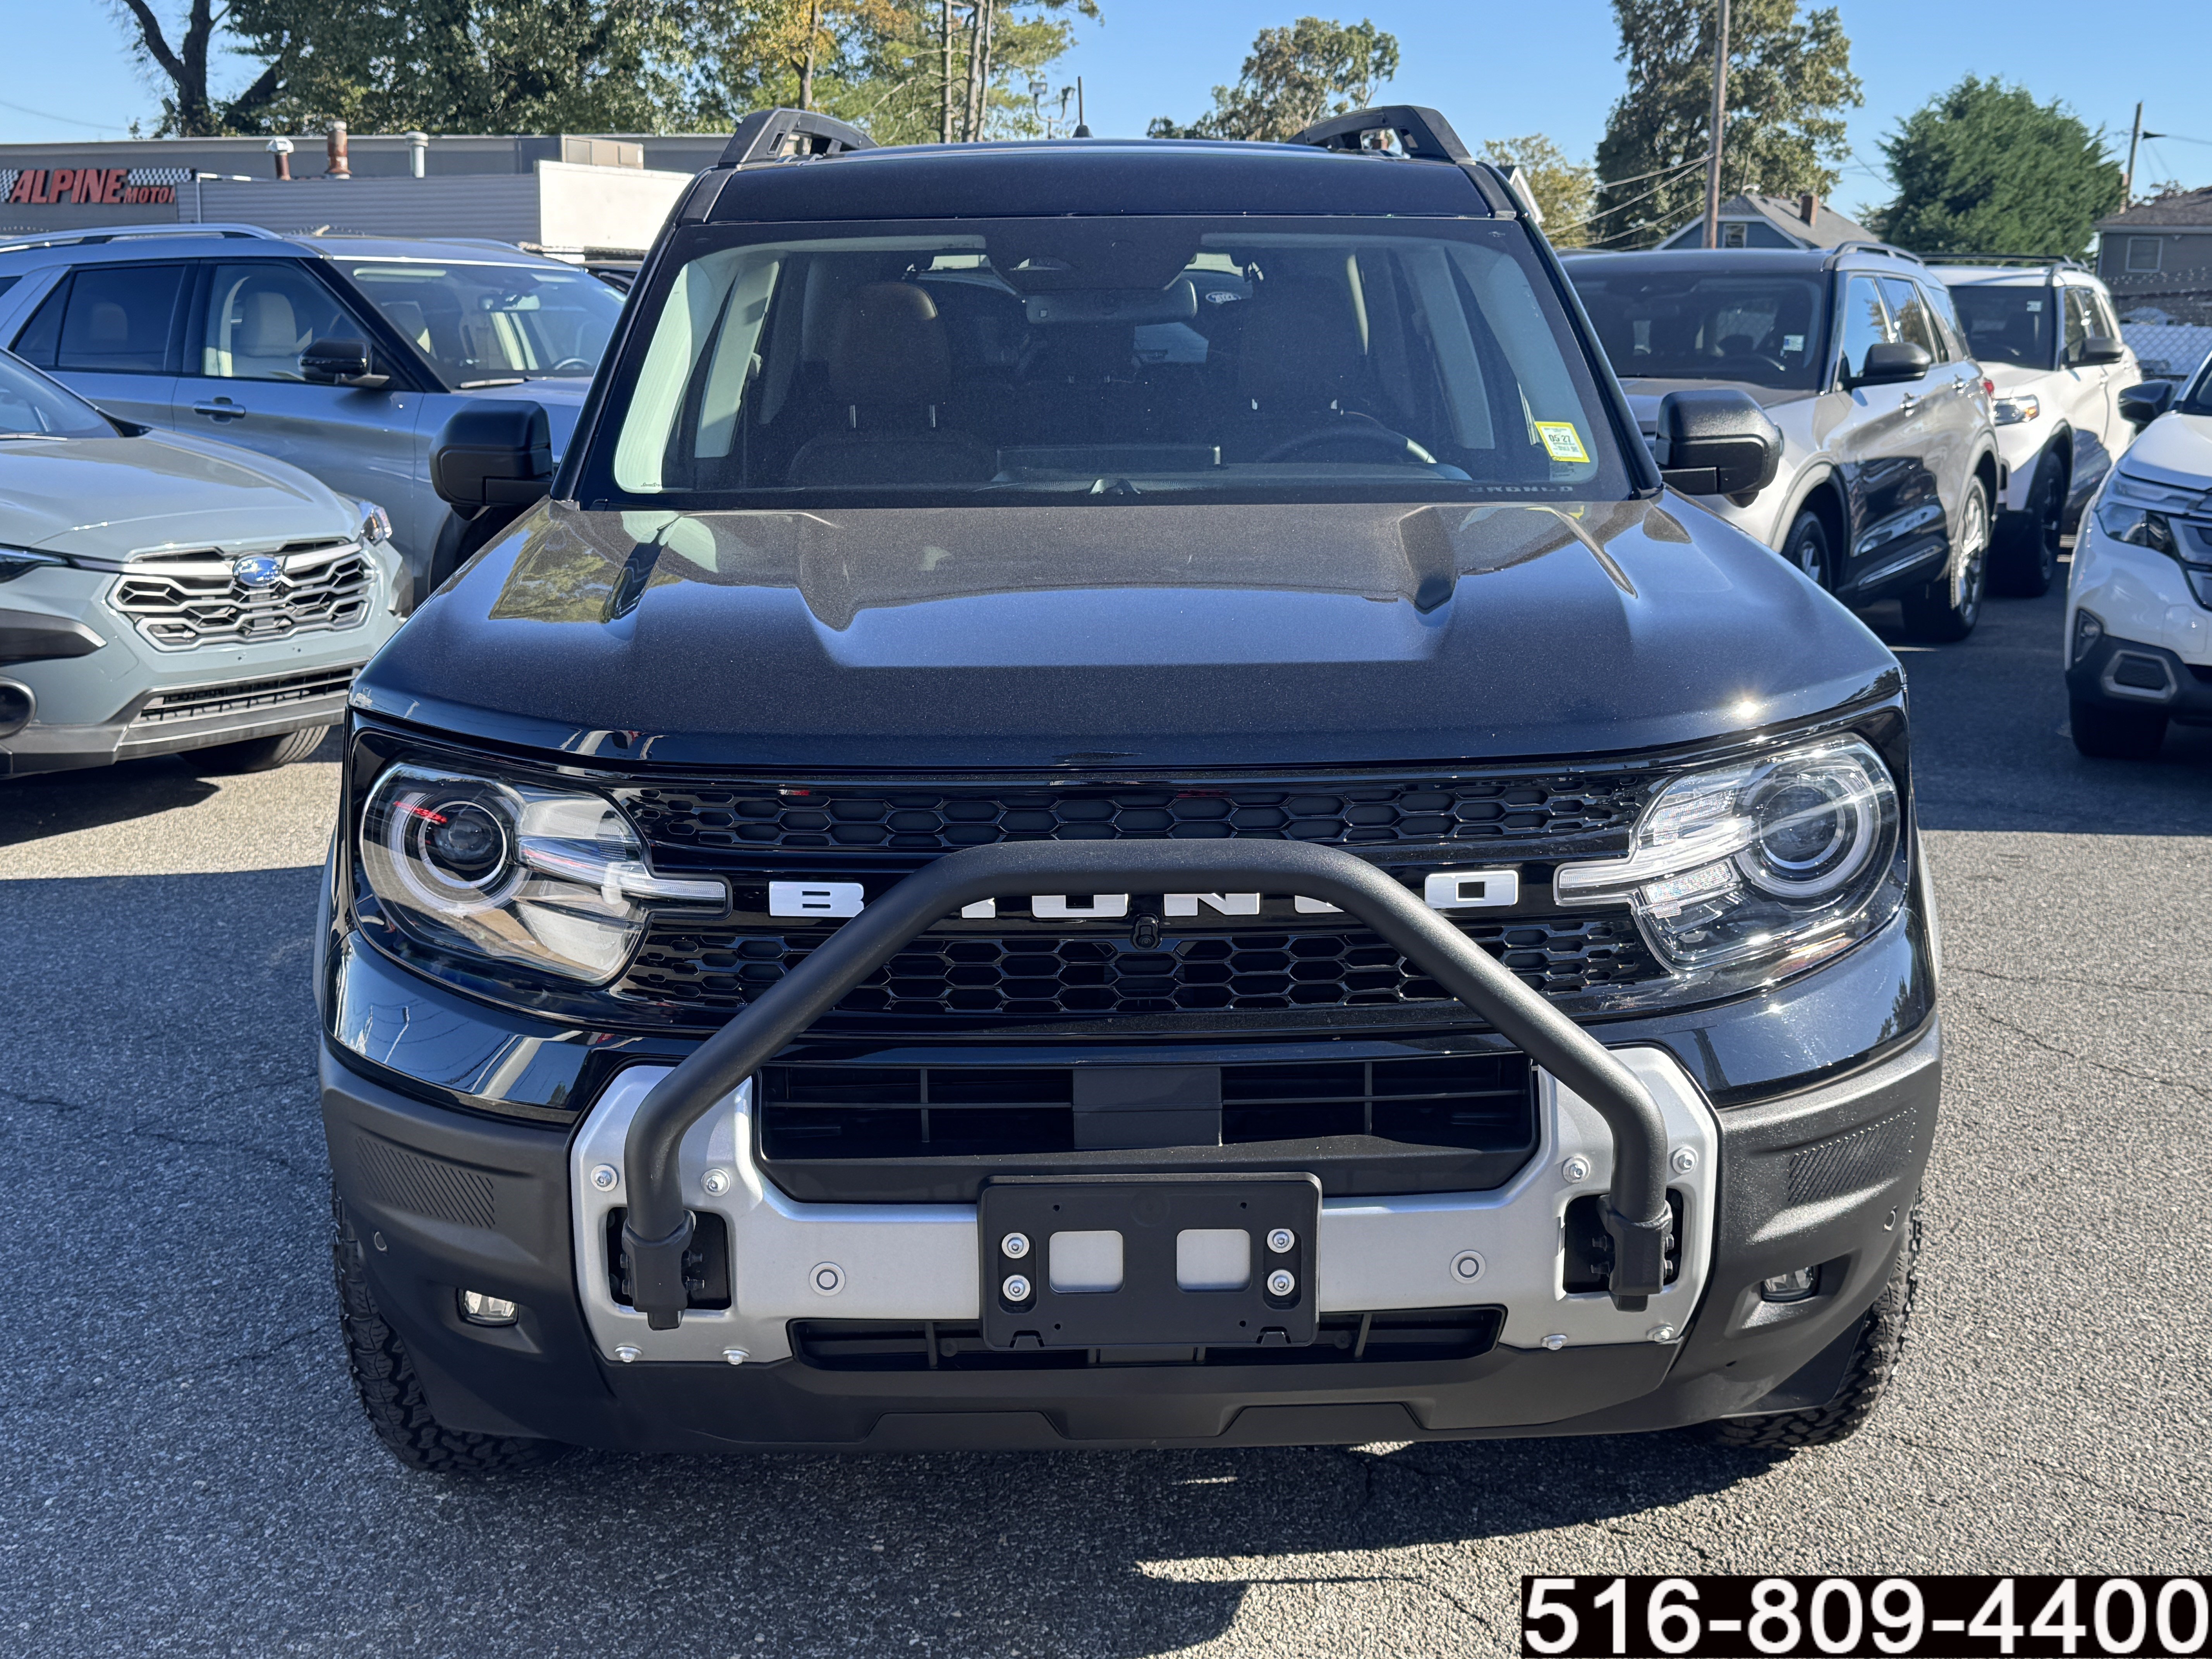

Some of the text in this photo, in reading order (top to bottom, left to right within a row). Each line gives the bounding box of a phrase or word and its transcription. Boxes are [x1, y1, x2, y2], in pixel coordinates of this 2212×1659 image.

[9, 169, 127, 203] ALPINE
[1561, 434, 1571, 443] 27
[769, 870, 1518, 918] BONO
